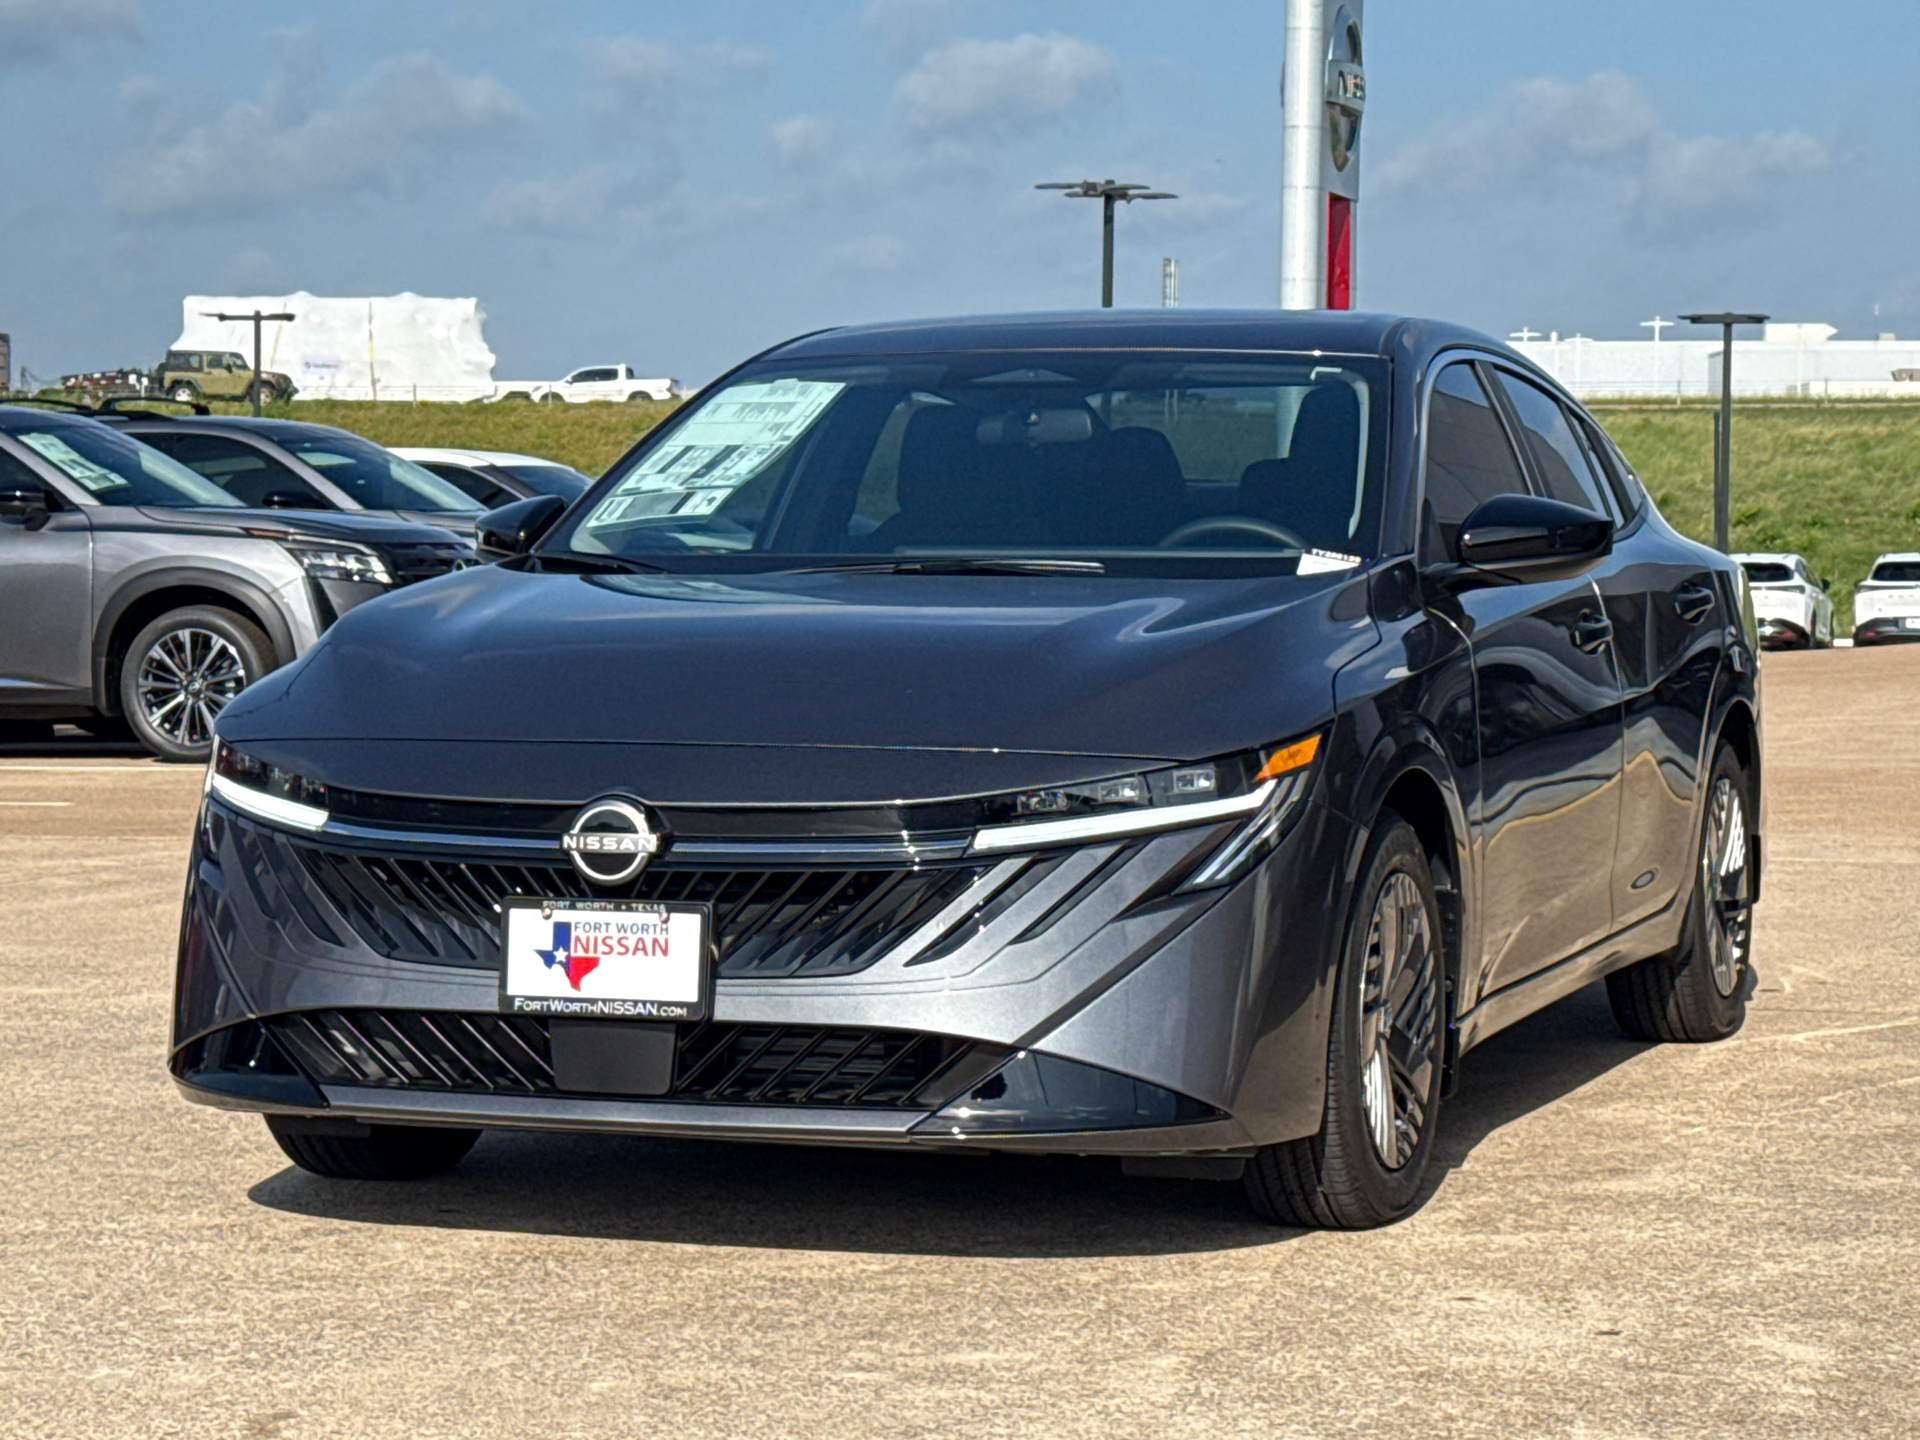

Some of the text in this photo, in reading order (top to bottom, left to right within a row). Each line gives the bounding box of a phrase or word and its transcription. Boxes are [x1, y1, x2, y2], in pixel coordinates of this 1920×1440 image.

[563, 835, 656, 851] NISSAN
[542, 900, 666, 913] FORT WORTH TEXAS
[574, 921, 669, 935] FORT WORTH
[574, 935, 669, 957] NISSAN
